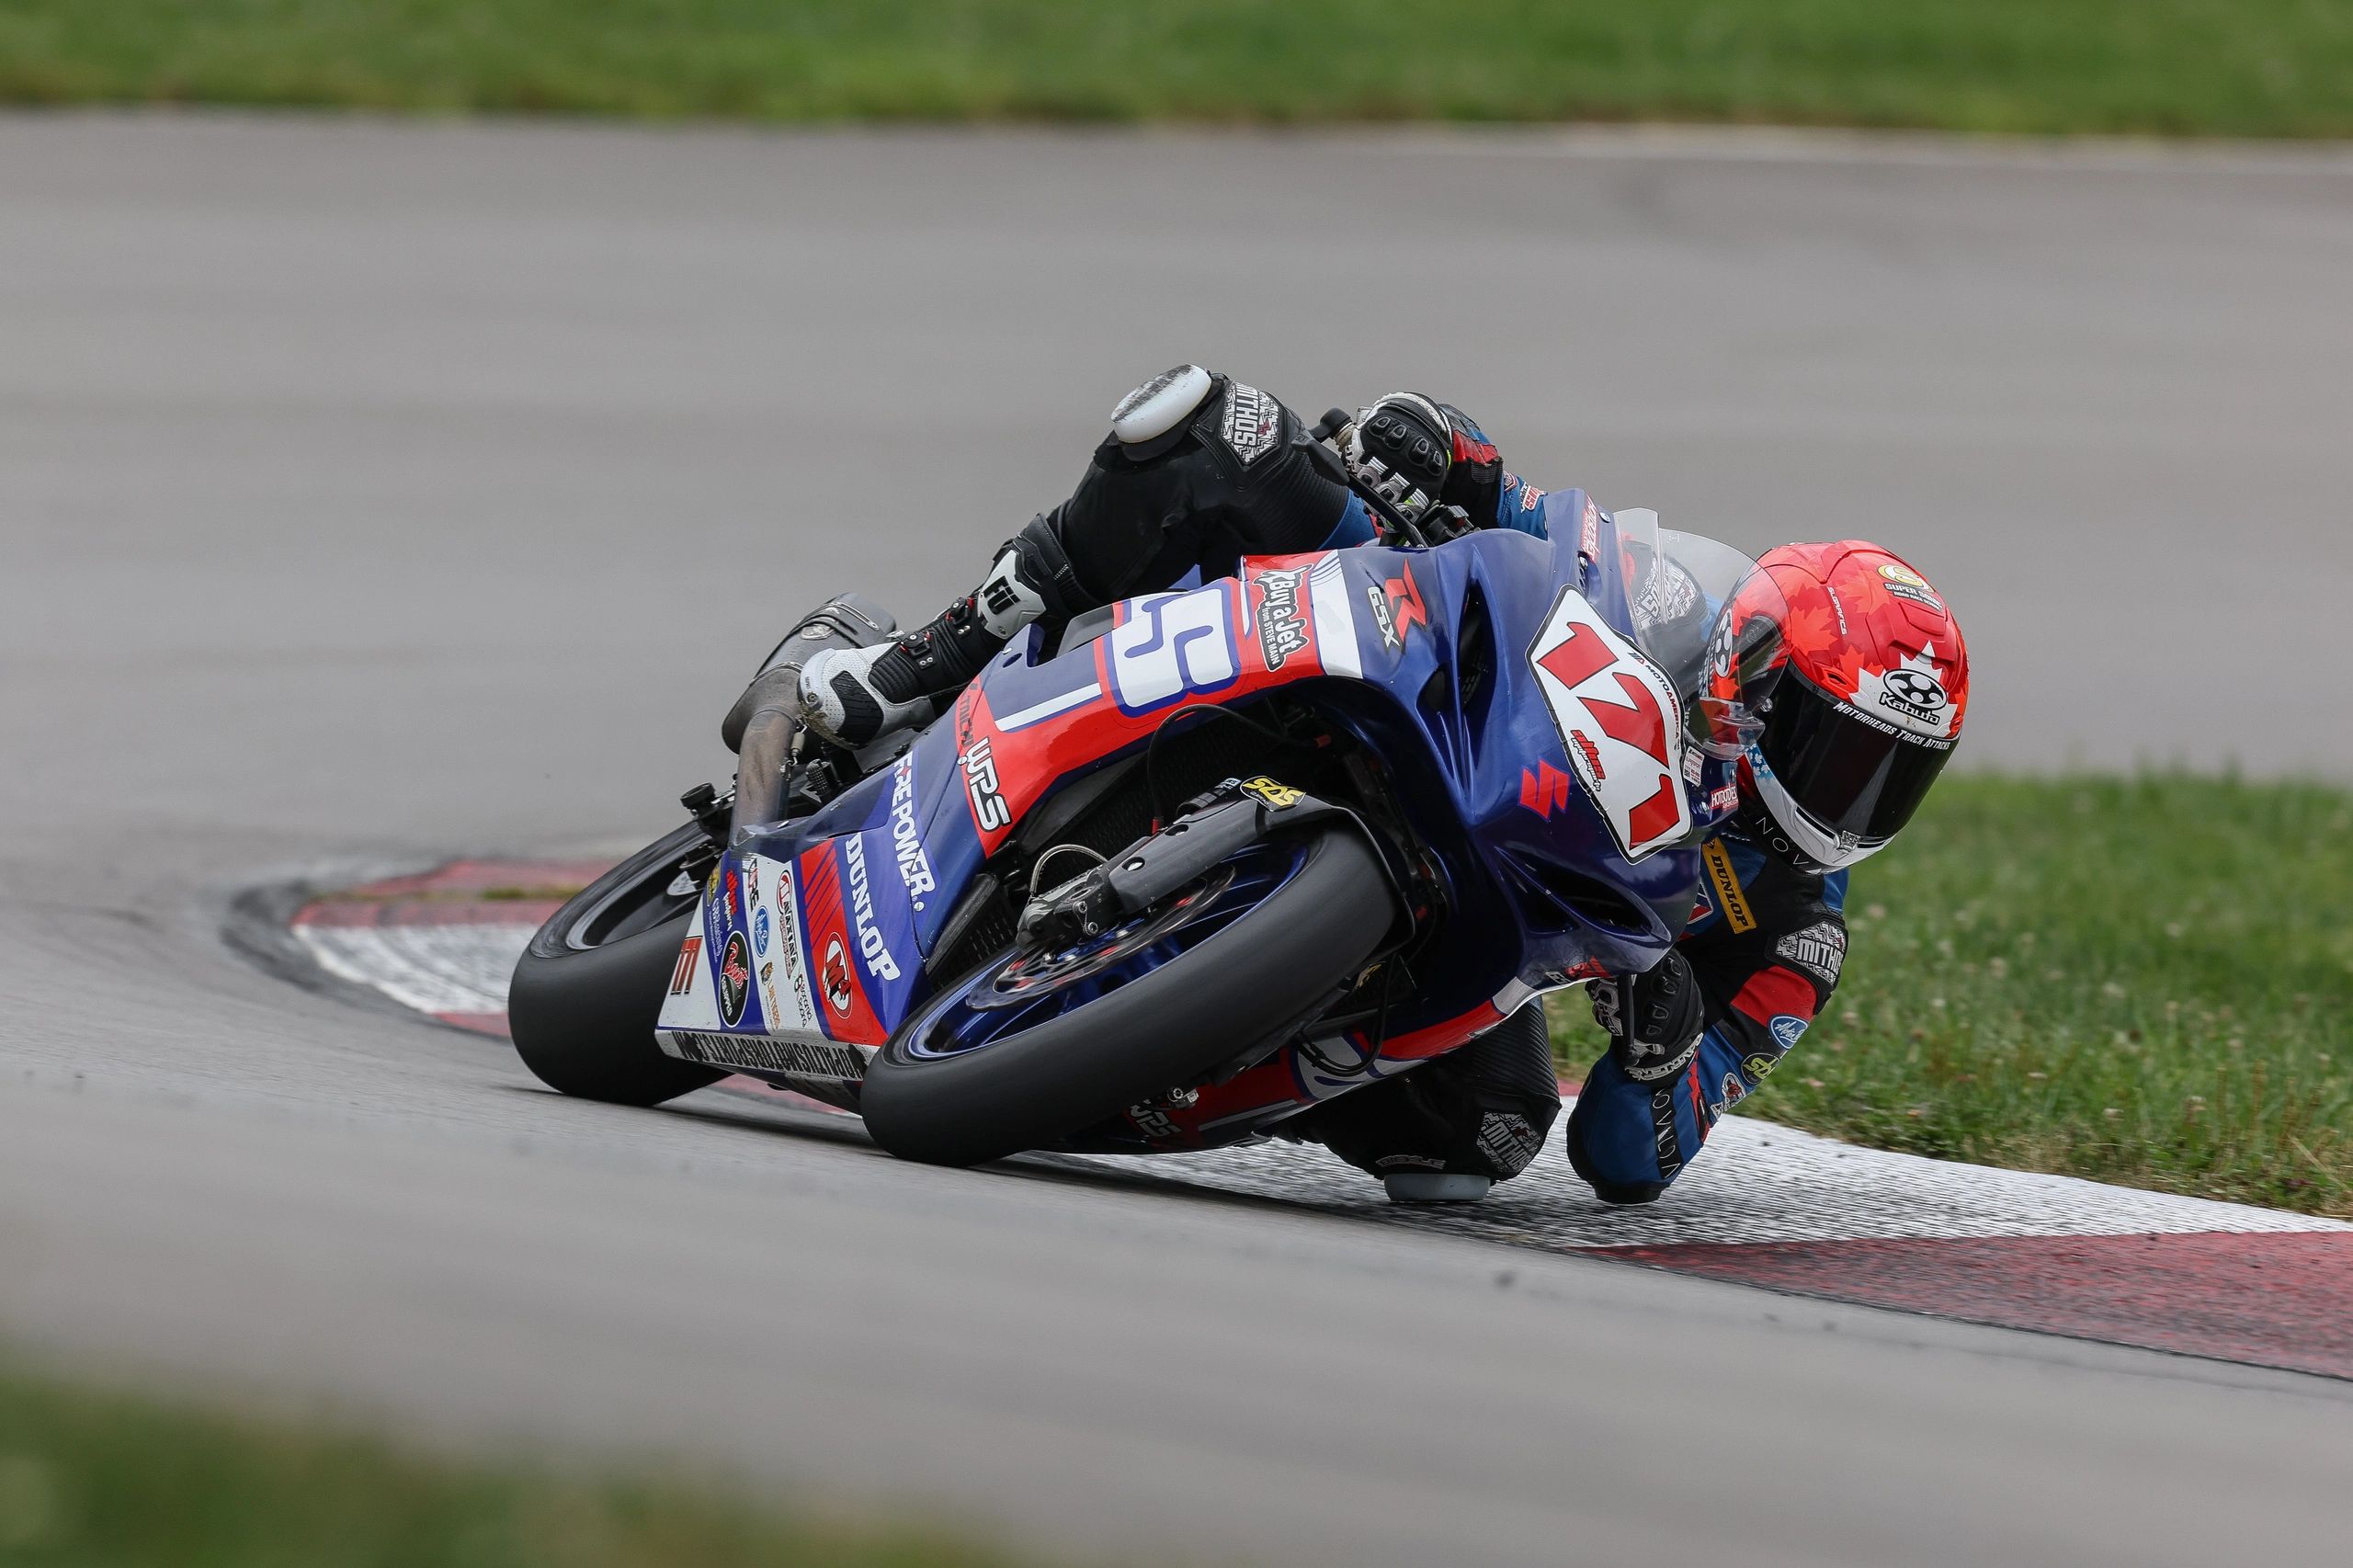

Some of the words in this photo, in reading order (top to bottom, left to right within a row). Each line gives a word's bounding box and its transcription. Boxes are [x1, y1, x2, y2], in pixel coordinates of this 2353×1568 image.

[1266, 581, 1294, 606] Buy
[1273, 607, 1291, 619] a
[1368, 586, 1400, 647] GSX
[1264, 621, 1275, 642] STEVE
[1268, 642, 1279, 665] MAIN
[1275, 619, 1304, 653] Jet
[1645, 663, 1679, 738] MOTOAMERICA
[1833, 701, 1895, 735] MOTORHEADS
[1895, 730, 1925, 745] TRACK
[1880, 692, 1940, 725] Kabuto
[1537, 622, 1680, 850] 171
[966, 737, 1010, 831] WPS
[846, 833, 900, 981] DUNLOP
[1711, 855, 1750, 926] DUNLOP
[824, 950, 853, 1001] M4
